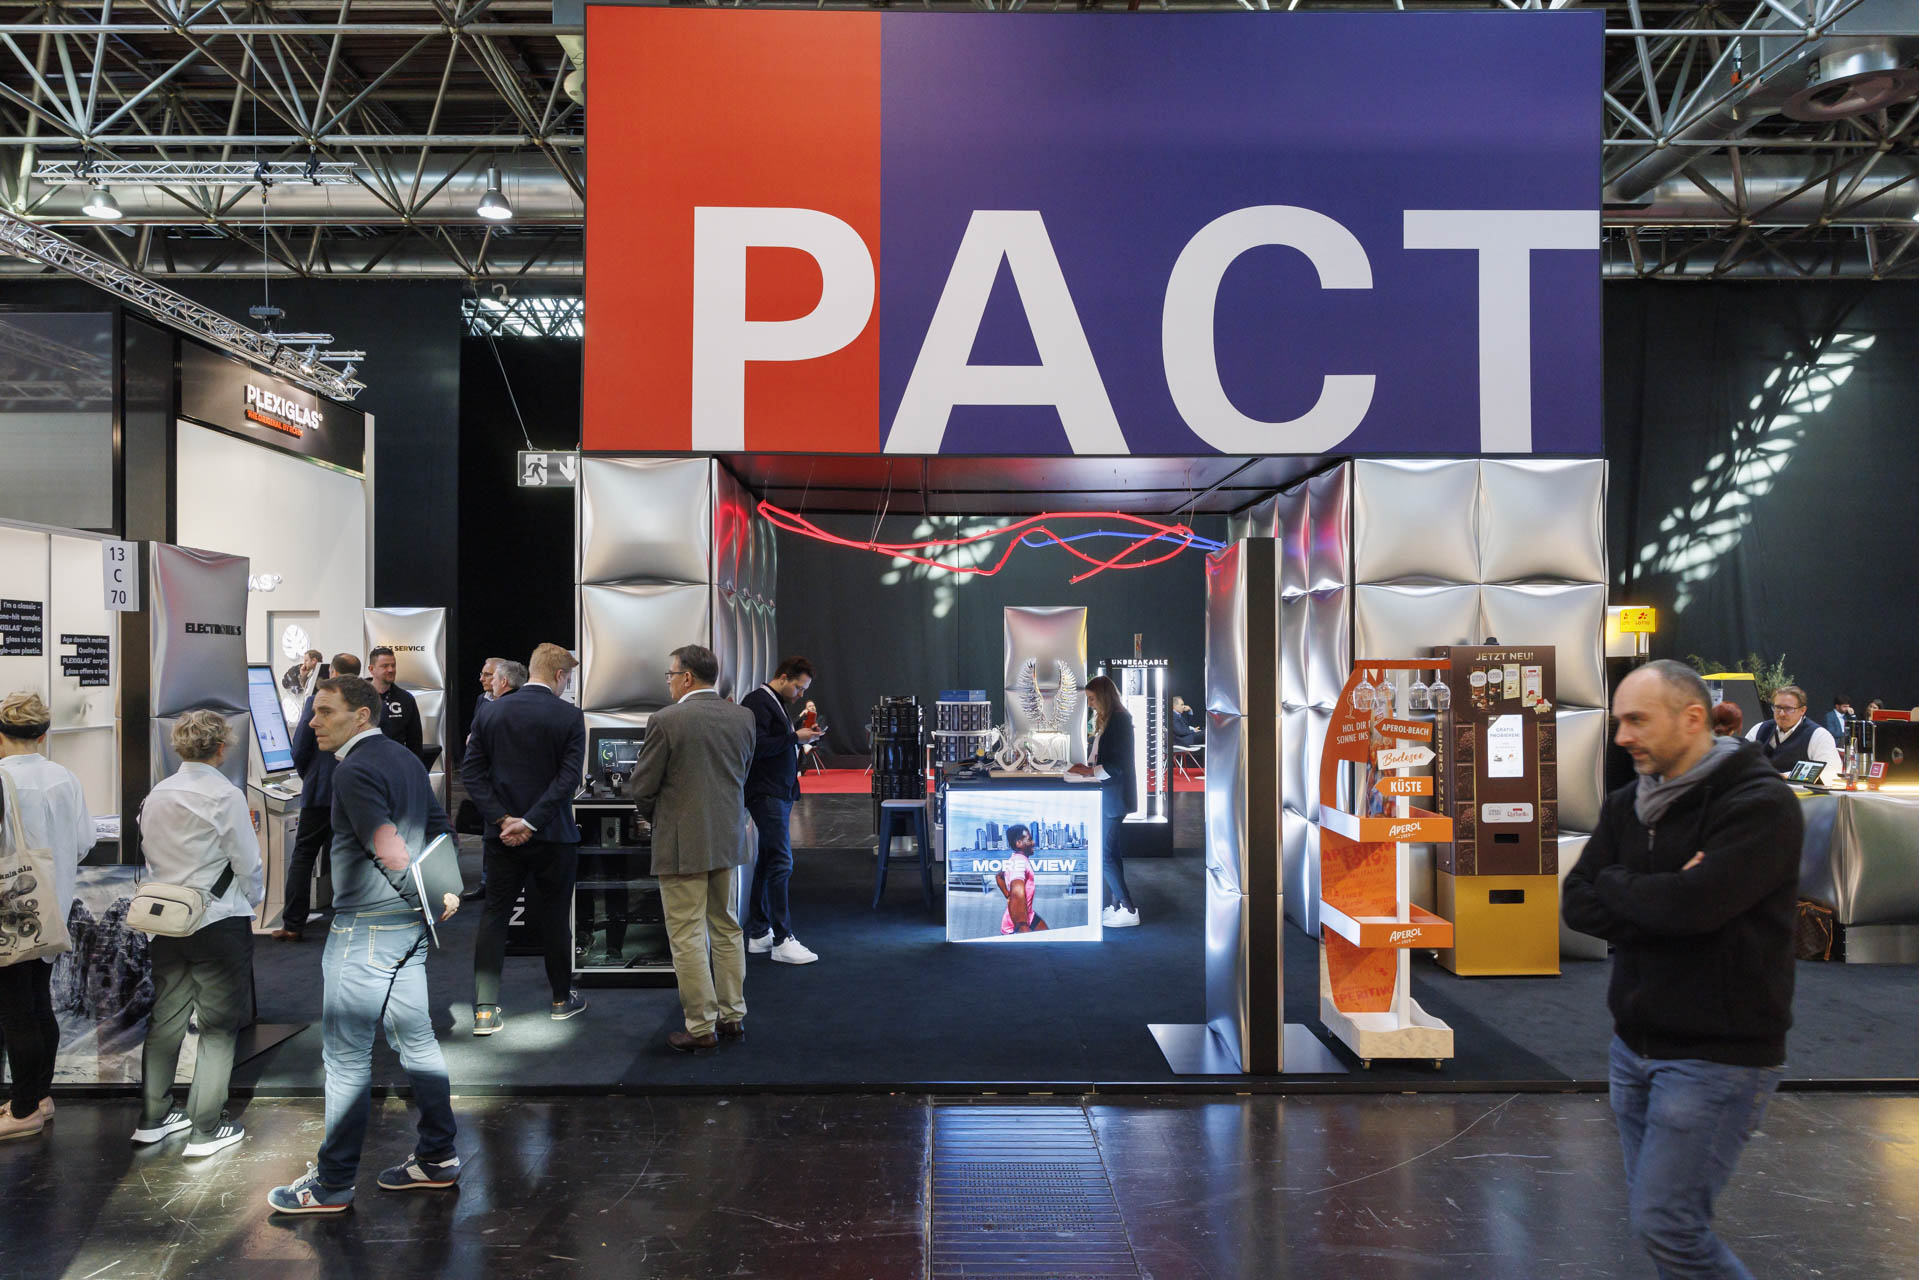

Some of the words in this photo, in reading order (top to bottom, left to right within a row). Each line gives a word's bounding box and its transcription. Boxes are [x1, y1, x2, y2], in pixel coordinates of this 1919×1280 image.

[692, 204, 1599, 454] PACT
[109, 546, 125, 562] 13
[113, 568, 123, 583] C
[110, 590, 127, 605] 70
[185, 622, 242, 636] ELECTRONICS
[1111, 658, 1169, 666] UNBREAKABLE
[1475, 652, 1506, 661] JETZT
[1509, 652, 1534, 661] NEU!
[1342, 723, 1354, 733] HOL
[1356, 720, 1367, 731] DIR
[1381, 723, 1429, 736] APEROL-BEACH
[1336, 734, 1356, 745] SONNE
[1359, 731, 1369, 742] INS
[1383, 751, 1423, 767] Badesee
[1390, 778, 1422, 793] KÜSTE
[1388, 822, 1422, 838] APEROL
[973, 859, 1026, 872] MORE
[1031, 859, 1077, 872] VIEW
[1389, 928, 1423, 943] APEROL
